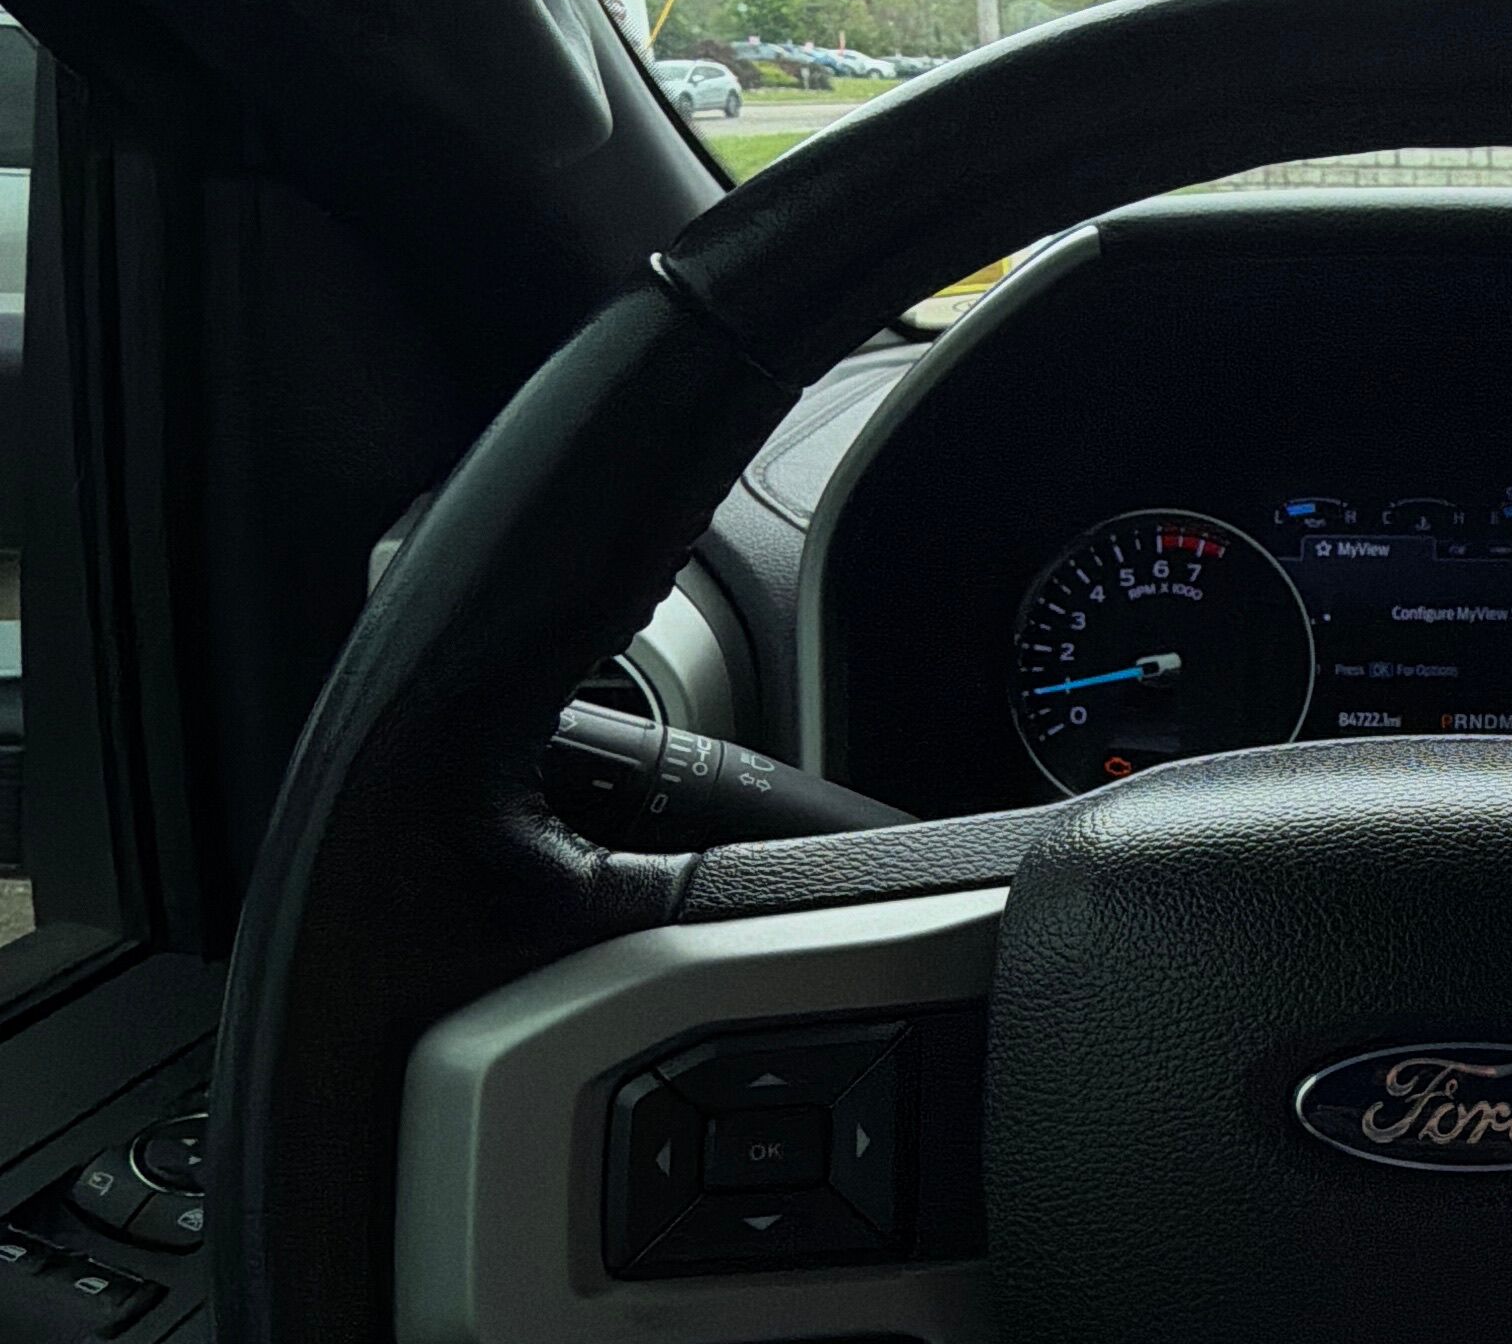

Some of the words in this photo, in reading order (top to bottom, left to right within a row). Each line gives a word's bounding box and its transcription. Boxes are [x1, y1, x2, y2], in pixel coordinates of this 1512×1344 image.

[1337, 542, 1391, 559] MyView
[1120, 569, 1135, 587] 5
[1152, 560, 1169, 578] 6
[1187, 564, 1201, 582] 7
[1089, 585, 1106, 602] 4
[1128, 584, 1156, 600] RPM
[1071, 612, 1086, 629] 3
[1392, 606, 1455, 623] Configure
[1456, 606, 1508, 623] MyView
[1060, 643, 1075, 661] 2
[1070, 706, 1087, 724] 0
[750, 1143, 785, 1161] OK
